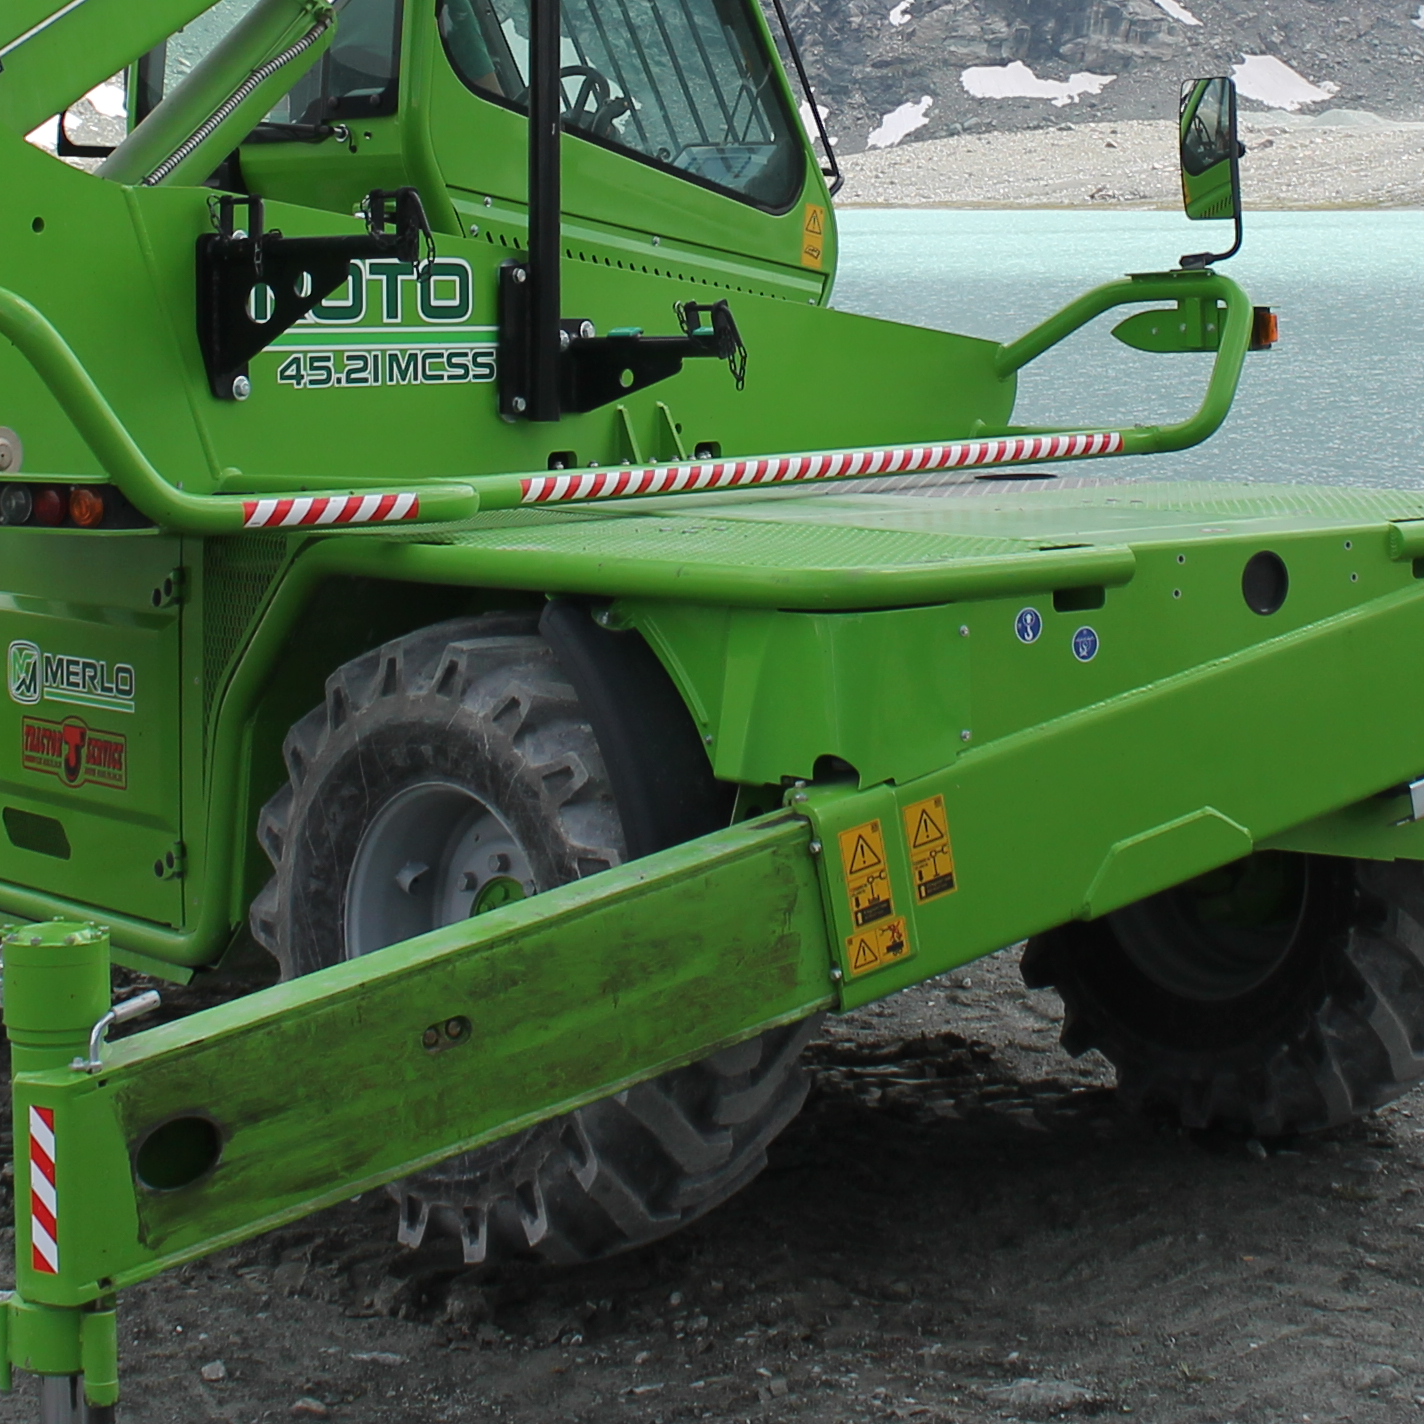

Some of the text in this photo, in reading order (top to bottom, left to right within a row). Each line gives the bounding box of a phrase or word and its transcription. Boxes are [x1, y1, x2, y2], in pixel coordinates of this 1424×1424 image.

[248, 258, 473, 324] OTO
[277, 348, 497, 389] 45.21 MCSS
[43, 652, 135, 699] MERLO
